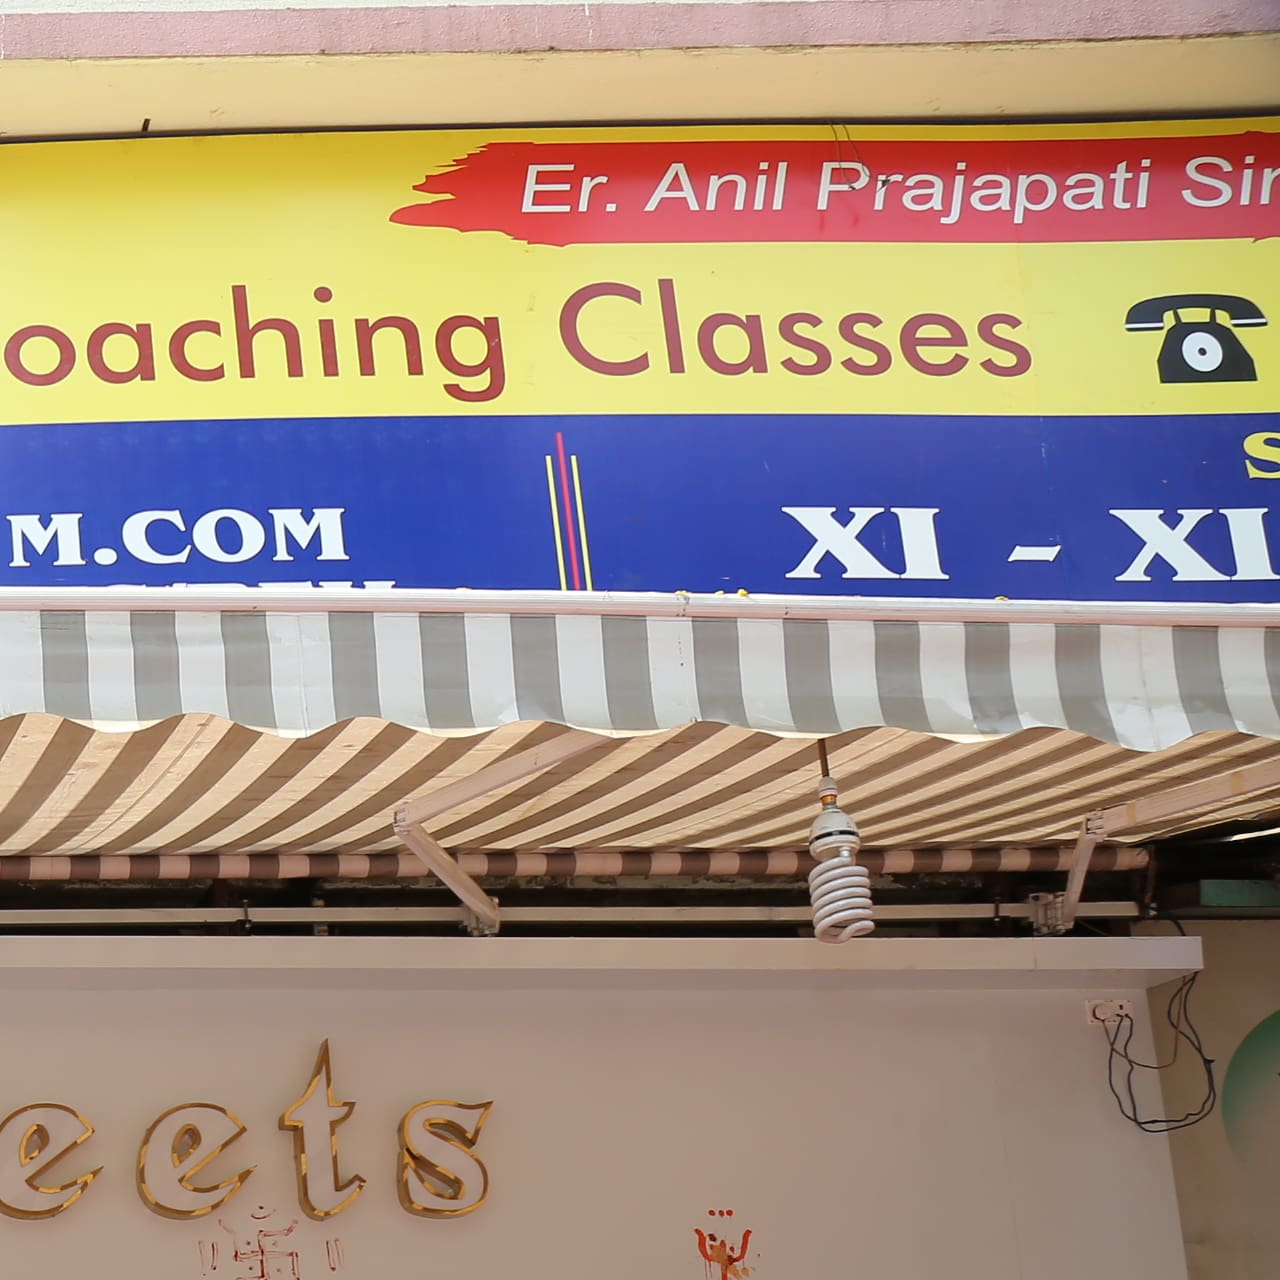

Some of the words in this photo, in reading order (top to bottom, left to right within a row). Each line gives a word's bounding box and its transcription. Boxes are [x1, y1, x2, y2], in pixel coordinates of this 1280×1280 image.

[520, 163, 618, 214] Er.
[644, 161, 789, 212] Anil
[816, 158, 1152, 225] Prajapati
[559, 278, 1033, 378] Classes
[7, 507, 351, 568] M.COM
[781, 506, 951, 581] XI
